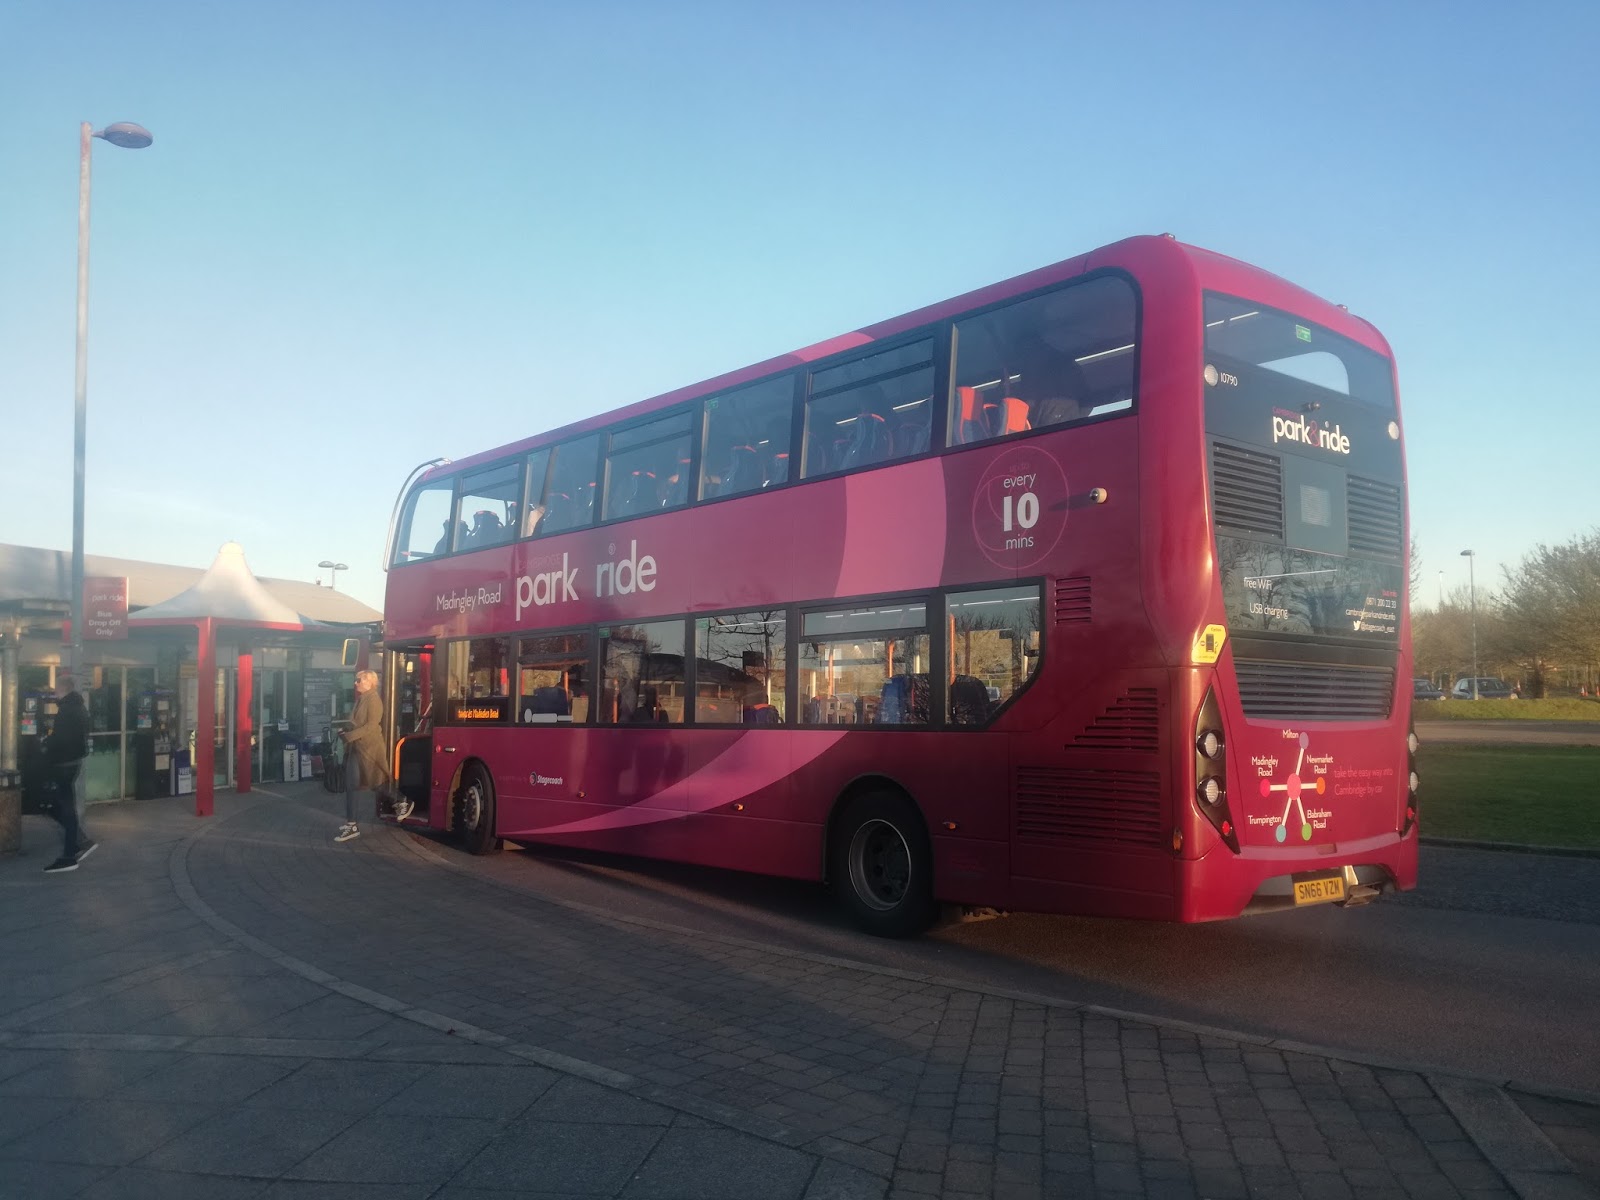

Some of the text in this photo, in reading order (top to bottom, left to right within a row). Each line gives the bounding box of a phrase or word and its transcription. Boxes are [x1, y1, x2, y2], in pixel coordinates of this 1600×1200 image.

[1220, 372, 1238, 387] 10790
[1003, 473, 1037, 489] every
[1003, 492, 1040, 532] 10
[1006, 533, 1034, 550] mins
[596, 539, 657, 598] ride
[515, 552, 579, 622] park
[1243, 578, 1257, 589] free
[436, 583, 502, 614] Madingley Road
[1249, 602, 1288, 620] USB charging
[88, 619, 107, 627] Drop
[95, 628, 113, 636] Only
[1283, 729, 1299, 739] Milton
[1251, 755, 1279, 767] Madingley
[1306, 754, 1334, 764] Newmarket
[1258, 768, 1273, 777] Road
[1314, 765, 1327, 775] Road
[1334, 769, 1346, 778] take
[1347, 769, 1357, 777] the
[1358, 769, 1370, 779] easy
[1371, 769, 1381, 778] way
[536, 774, 563, 786] Stagecoach
[1334, 784, 1383, 797] Cambridge by car
[1306, 809, 1332, 819] Babraham
[1248, 815, 1282, 826] Trumpington
[1313, 821, 1326, 829] Road
[1299, 882, 1322, 900] SN66
